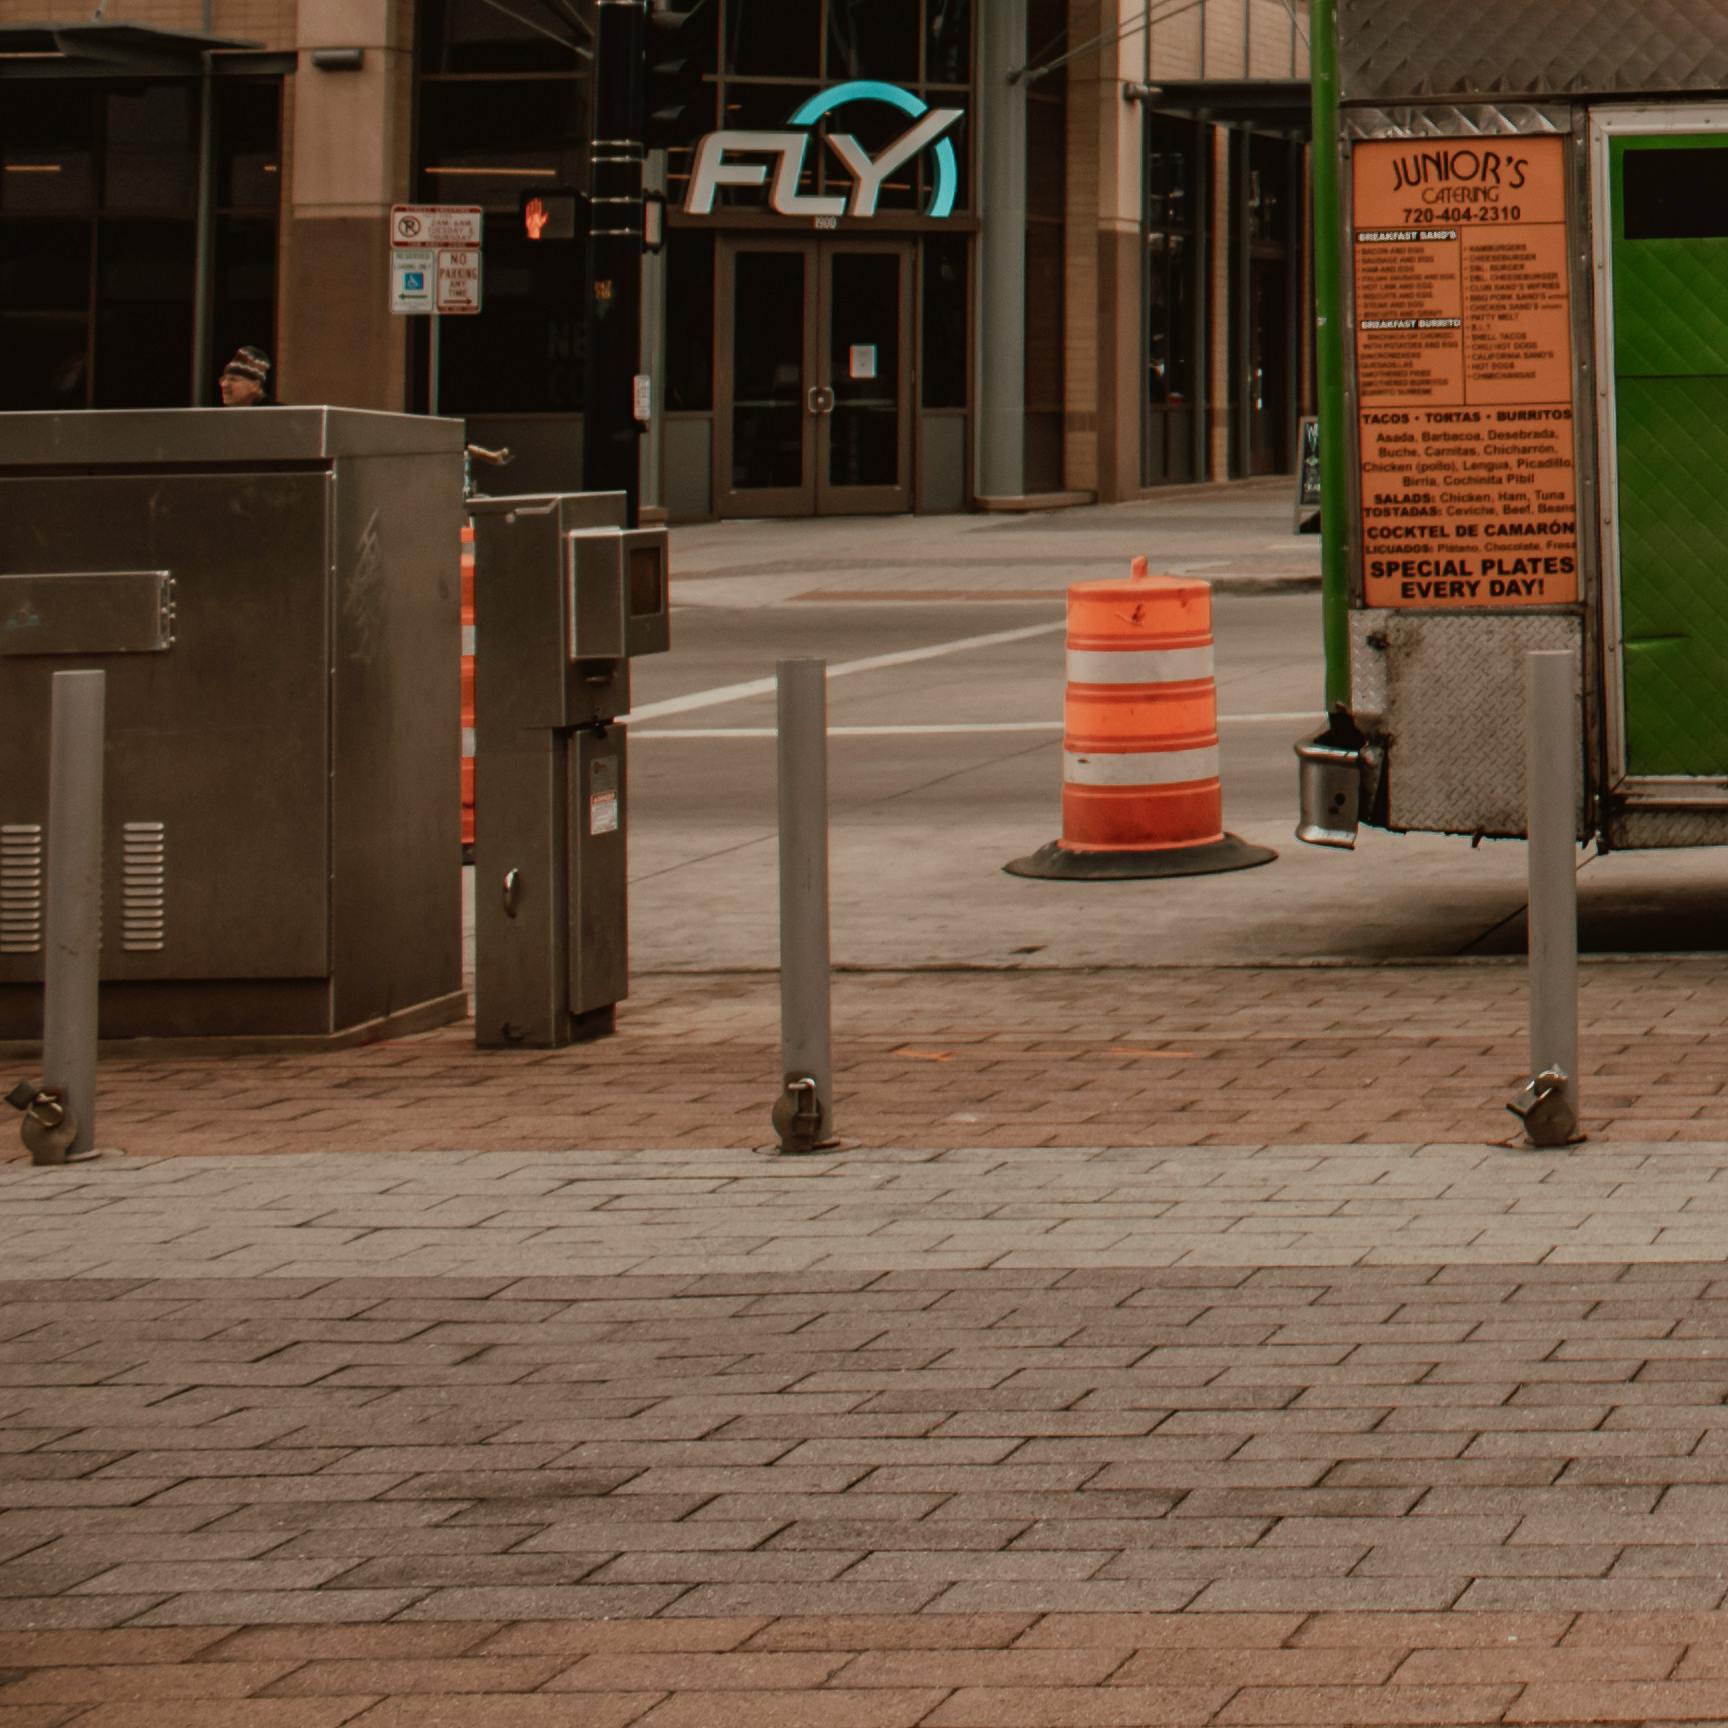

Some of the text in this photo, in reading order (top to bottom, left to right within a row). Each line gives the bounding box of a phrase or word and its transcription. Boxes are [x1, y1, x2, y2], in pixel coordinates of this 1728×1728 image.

[684, 109, 965, 217] FLY
[1393, 150, 1528, 192] JUNIOR'S
[1421, 186, 1499, 204] CATERING
[1403, 206, 1521, 223] 720-404-2310
[1358, 231, 1418, 242] BREAKFAST
[1361, 320, 1417, 330] BREAKFAST
[1362, 409, 1572, 424] TACOS TORTAS BURRITOS
[1443, 474, 1503, 486] Cochinita
[1374, 493, 1436, 505] SALADS:
[1534, 489, 1566, 500] Tuna
[1365, 506, 1443, 518] TOSTADAS:
[1367, 519, 1576, 540] COCKTEL DE CAMARÓN
[1370, 556, 1575, 578] SPECIAL PLATES
[1401, 578, 1545, 598] EVERY DAY!
